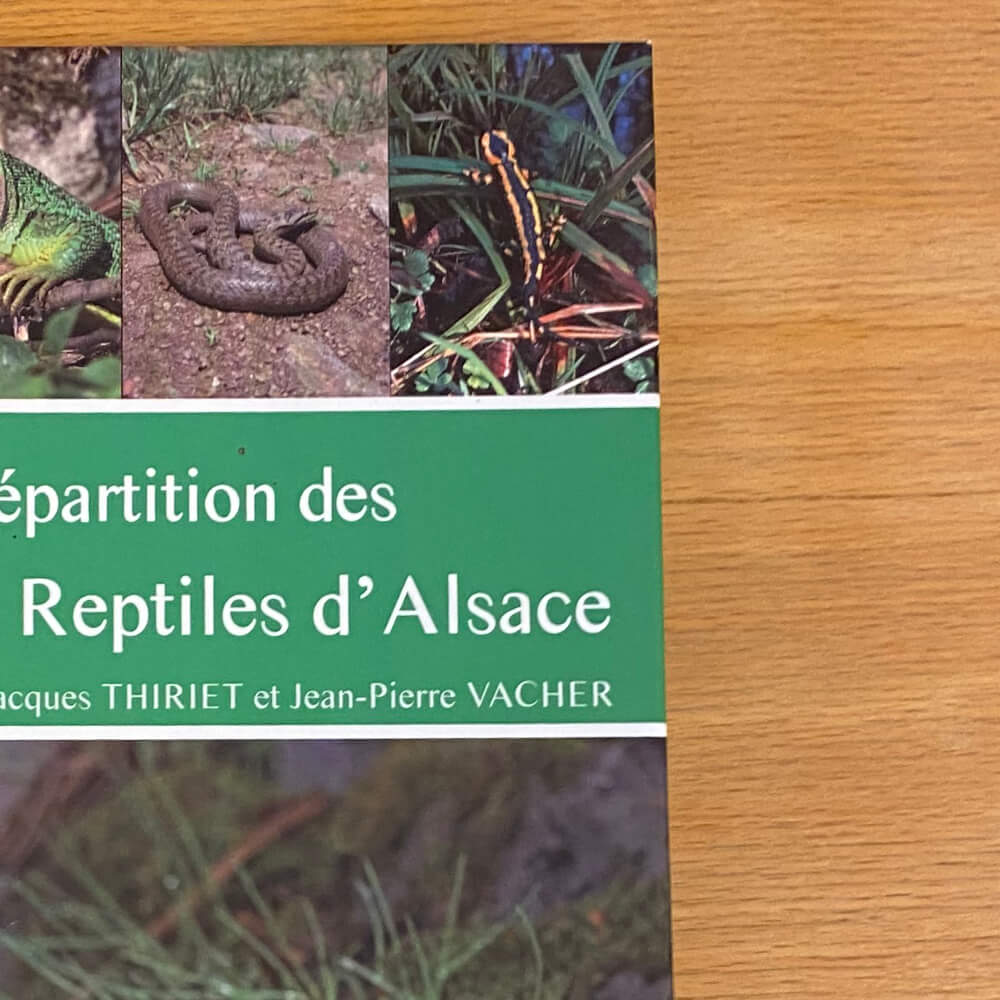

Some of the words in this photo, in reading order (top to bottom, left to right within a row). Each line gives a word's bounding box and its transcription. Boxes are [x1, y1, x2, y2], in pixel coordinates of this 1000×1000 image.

[298, 465, 397, 523] des
[22, 574, 289, 654] Reptiles
[101, 683, 243, 710] THIRIET
[253, 685, 280, 710] et
[289, 682, 456, 710] Jean-Pierre
[467, 680, 613, 708] VACHER
